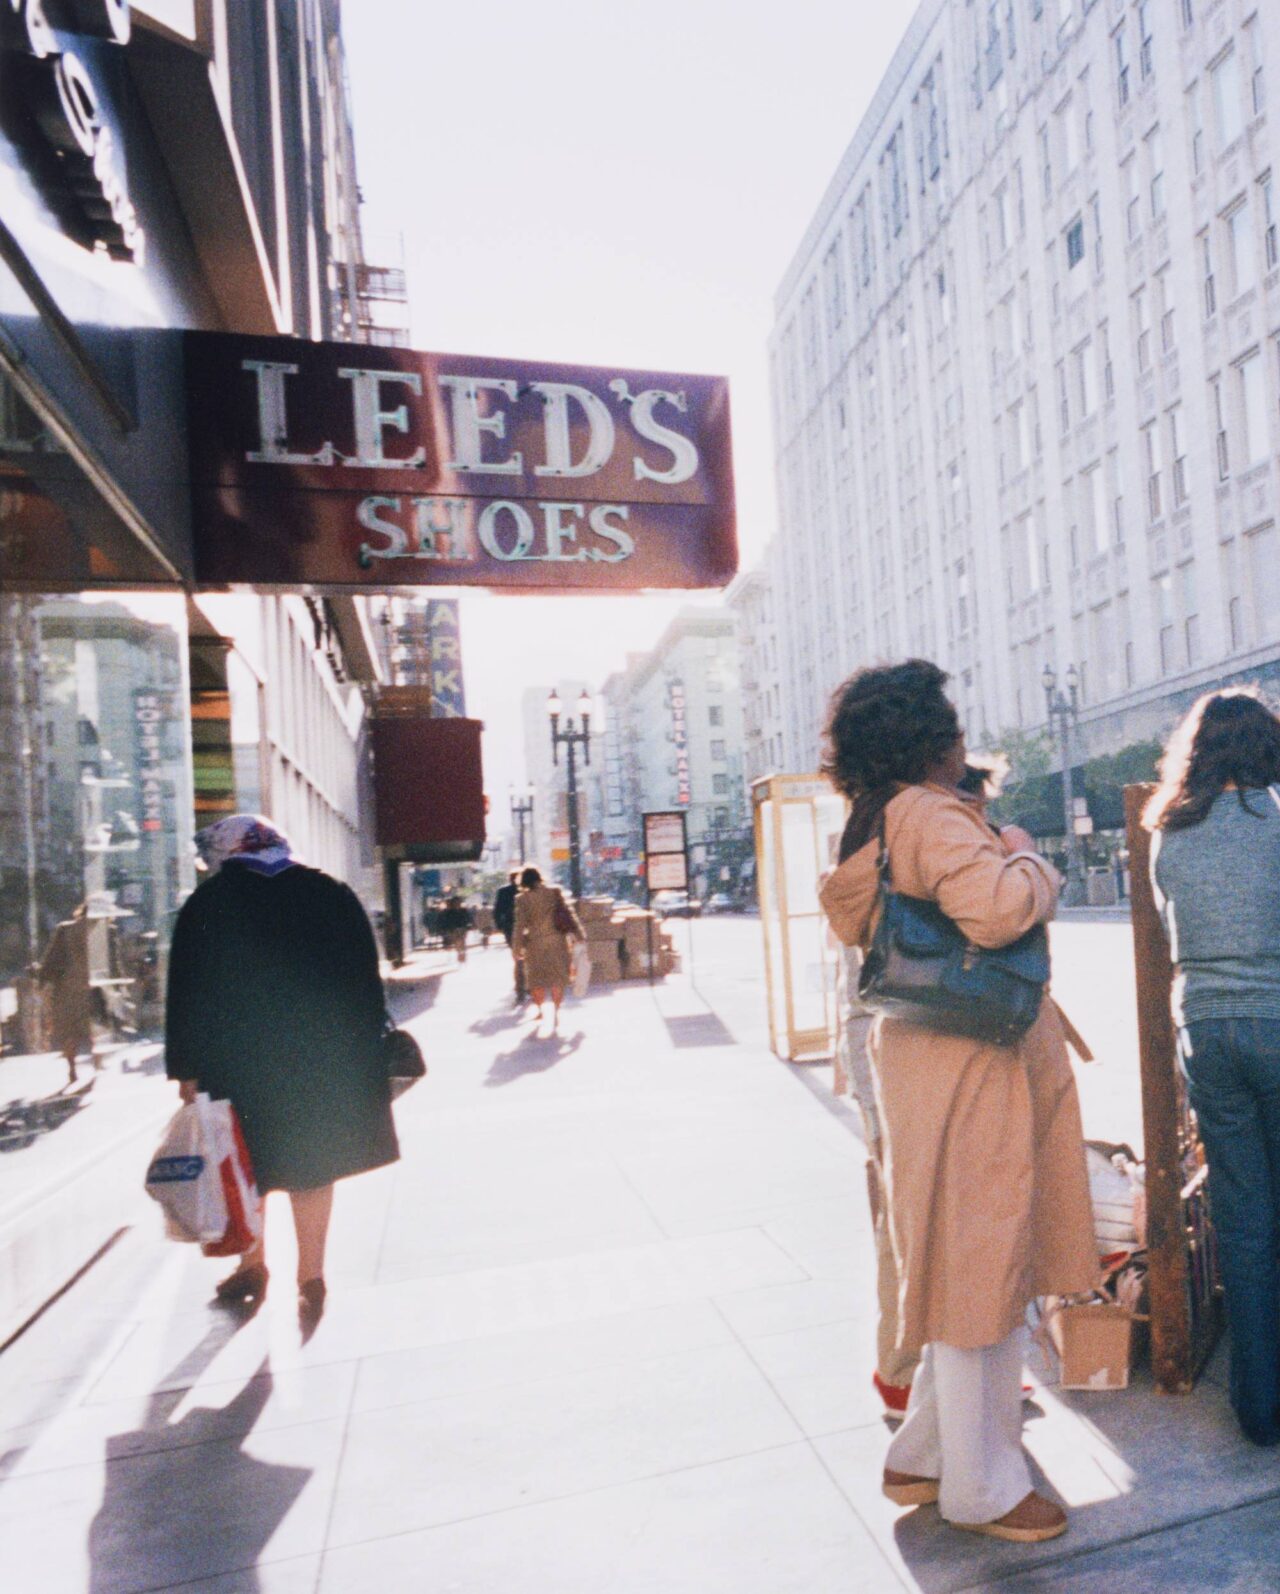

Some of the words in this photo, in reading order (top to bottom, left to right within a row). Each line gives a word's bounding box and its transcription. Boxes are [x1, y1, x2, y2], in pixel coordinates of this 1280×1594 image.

[241, 359, 699, 485] LEED'S
[356, 496, 636, 566] SHOES
[671, 685, 686, 742] HOTEL
